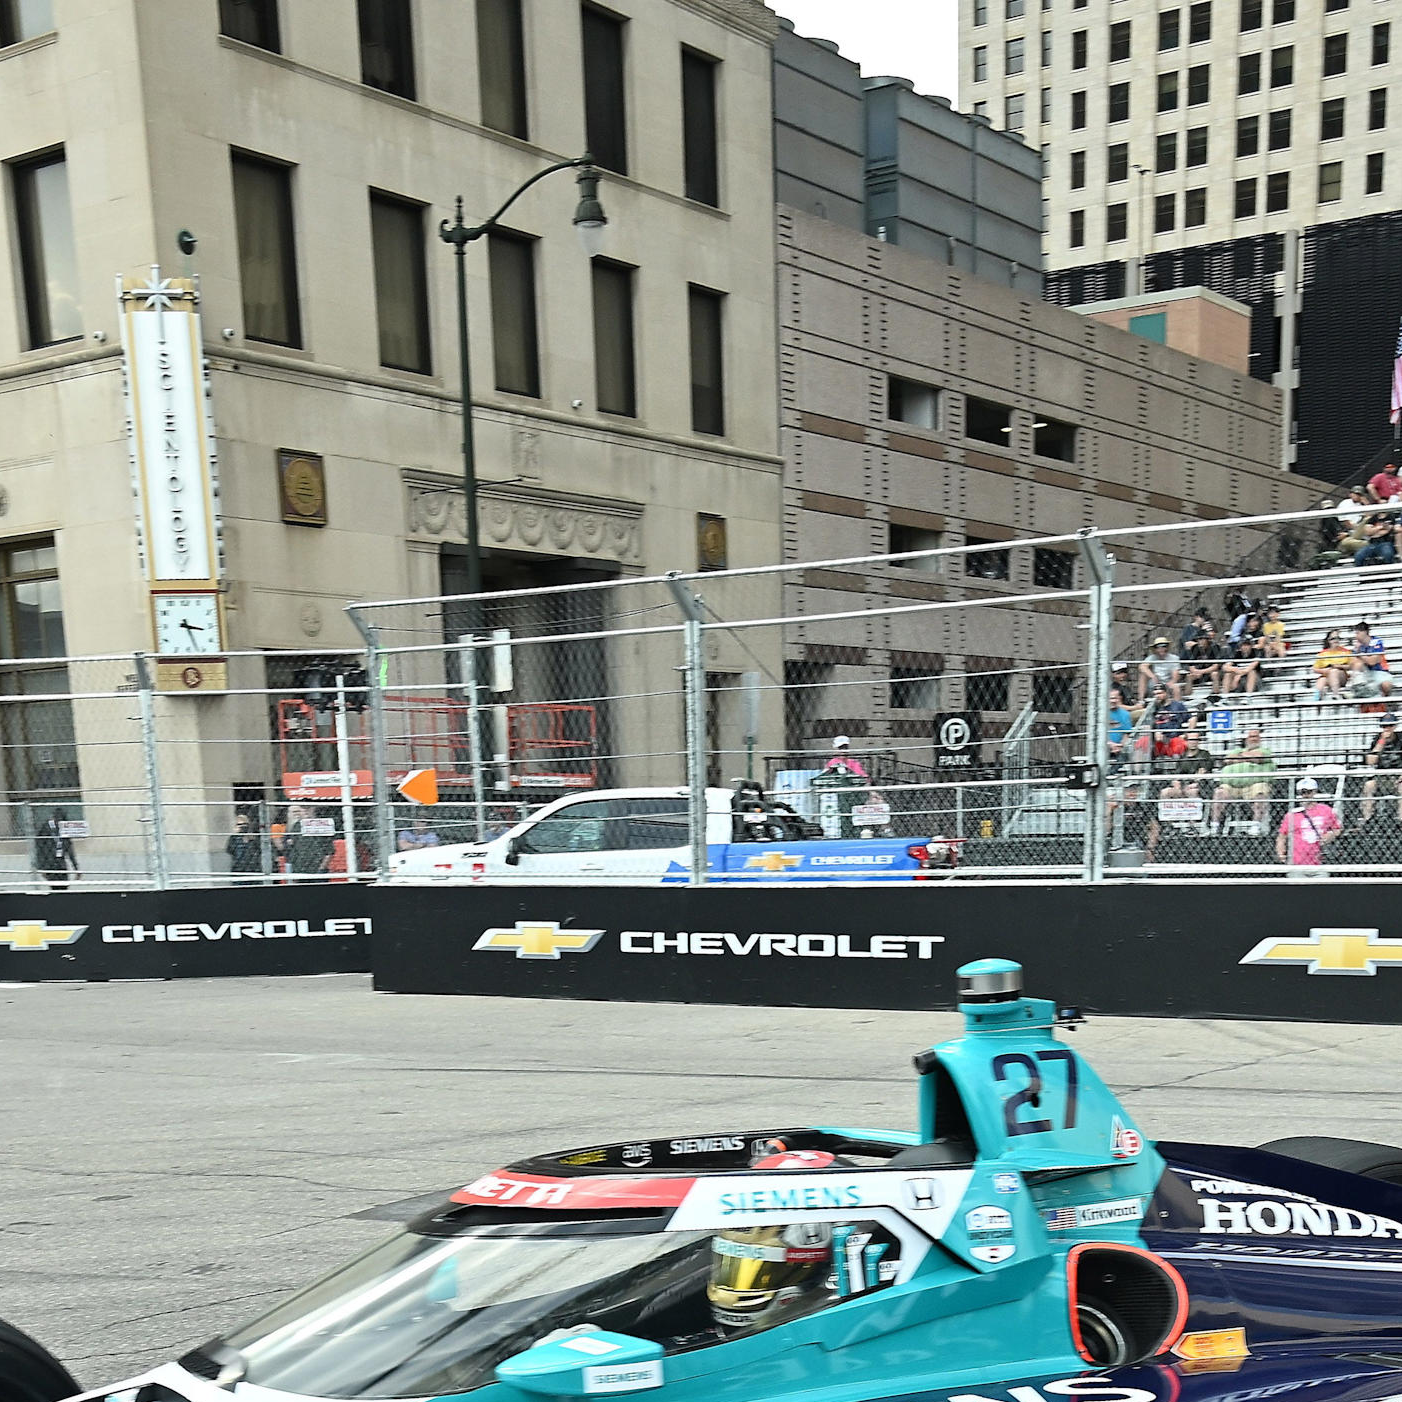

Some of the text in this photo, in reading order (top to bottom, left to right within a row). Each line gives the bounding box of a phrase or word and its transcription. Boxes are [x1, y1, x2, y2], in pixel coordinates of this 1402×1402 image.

[938, 755, 971, 766] PARK
[810, 855, 896, 866] CHEVROLET
[619, 931, 945, 959] CHEVROLET
[992, 1049, 1079, 1137] 27
[670, 1136, 745, 1155] SIEMENS
[719, 1185, 863, 1216] SIEMENS
